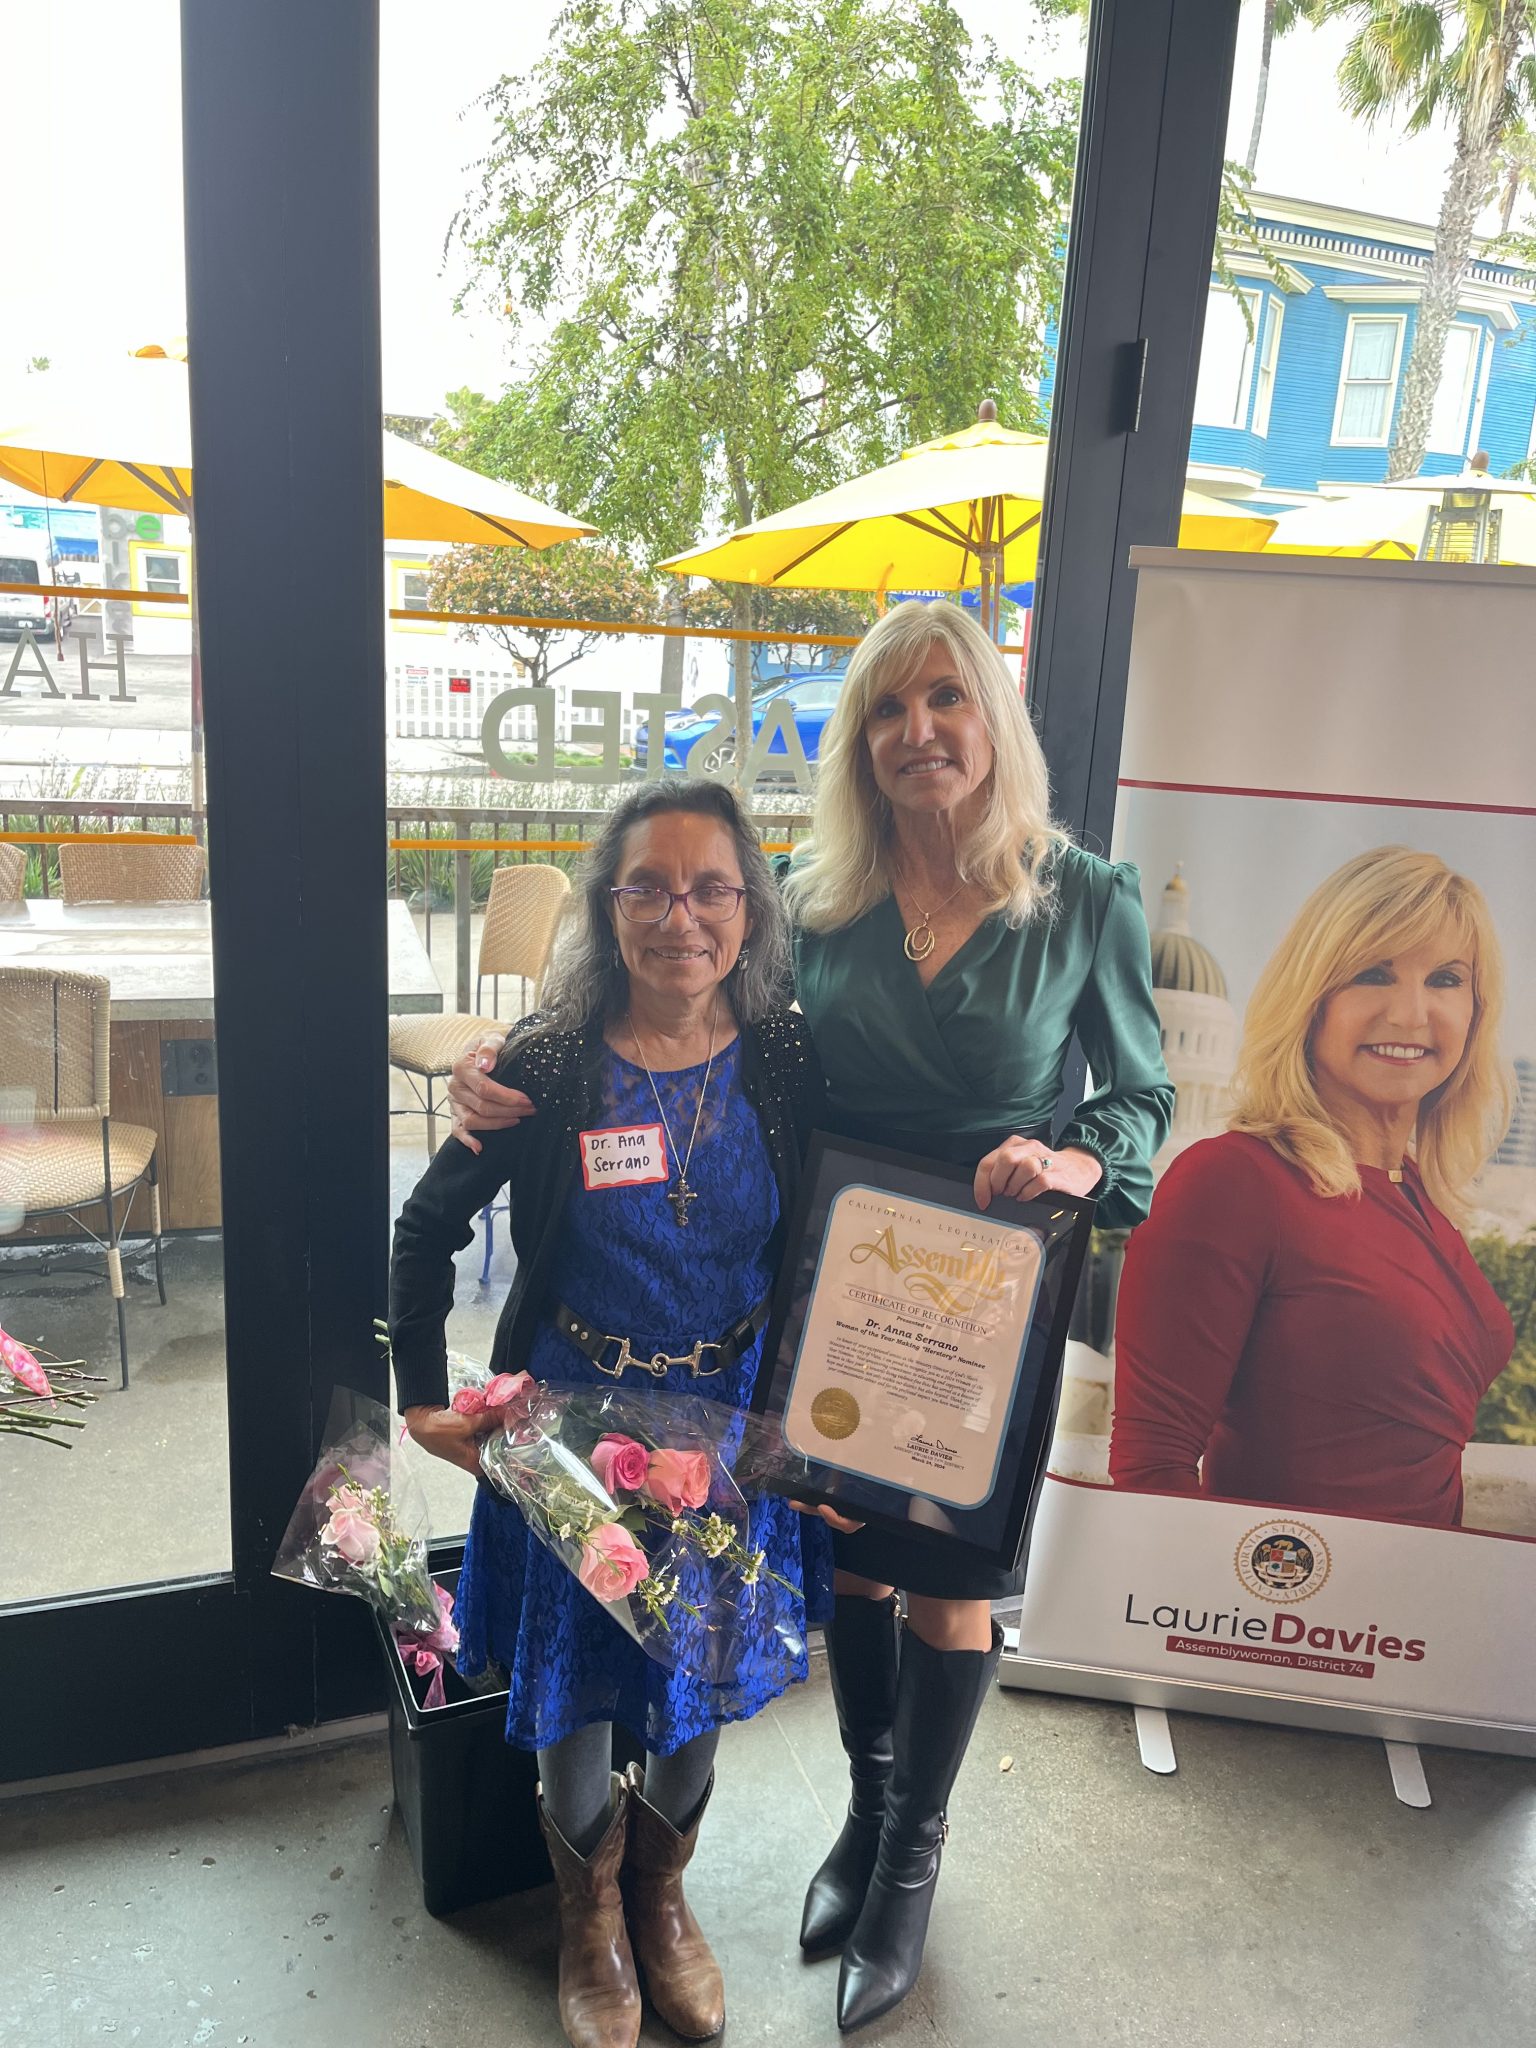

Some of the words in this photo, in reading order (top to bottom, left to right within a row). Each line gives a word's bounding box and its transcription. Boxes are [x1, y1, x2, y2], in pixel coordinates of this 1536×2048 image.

[591, 1139, 611, 1151] Dr.
[618, 1134, 646, 1149] Ana
[593, 1155, 650, 1173] Serrano
[848, 1198, 922, 1225] CALIFORNIA
[938, 1222, 1030, 1254] LEGISLATURE
[850, 1225, 1006, 1315] Assembly
[848, 1288, 907, 1312] CERTIFICATE
[907, 1305, 920, 1315] OF
[921, 1309, 988, 1335] RECOGNITION
[896, 1315, 925, 1328] Presented
[835, 1320, 859, 1332] Woman
[860, 1327, 868, 1335] of
[879, 1333, 895, 1342] Year
[895, 1338, 920, 1350] Making
[957, 1356, 986, 1369] Nominee
[865, 1318, 882, 1329] Dr.
[883, 1323, 913, 1338] Anna
[914, 1332, 959, 1352] Serrano
[906, 1443, 929, 1453] LAURIE
[929, 1450, 953, 1461] DAVIES
[1271, 1524, 1314, 1544] STATE
[1241, 1533, 1273, 1597] CALIFORNIA
[1282, 1550, 1324, 1599] ASSEMBLY
[1175, 1639, 1294, 1667] Assemblywoman,
[1297, 1654, 1347, 1673] District
[1349, 1662, 1365, 1675] 74
